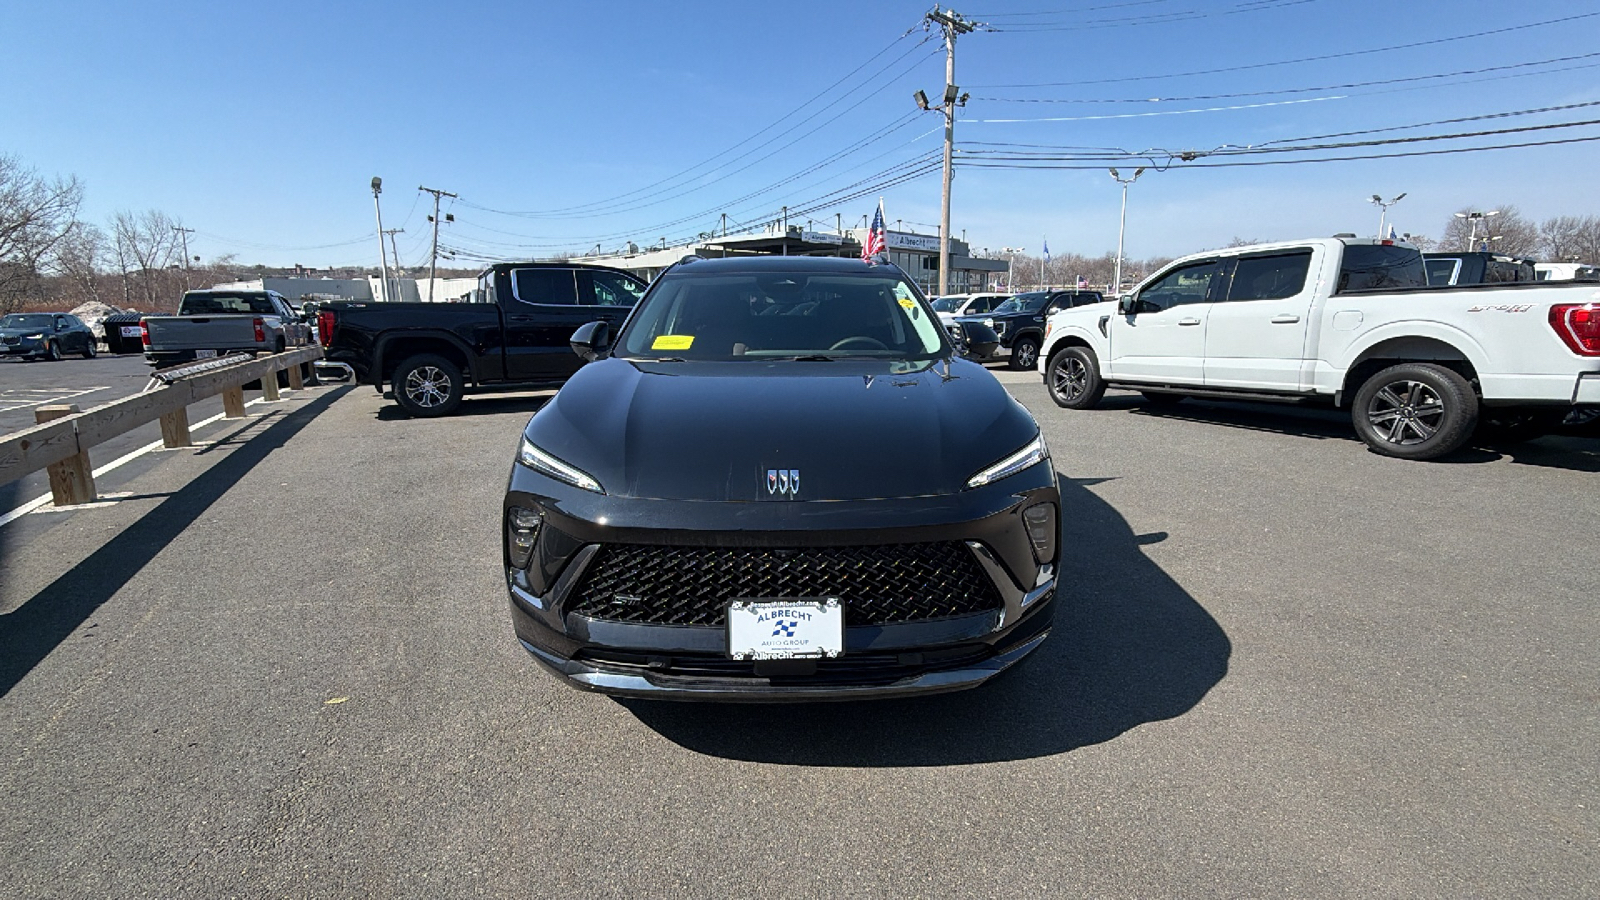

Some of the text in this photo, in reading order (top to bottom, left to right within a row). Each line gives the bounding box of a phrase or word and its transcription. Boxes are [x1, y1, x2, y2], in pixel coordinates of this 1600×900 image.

[899, 236, 926, 247] Albrecht
[757, 609, 812, 623] ALBRECHT
[751, 651, 794, 661] Albrecht
